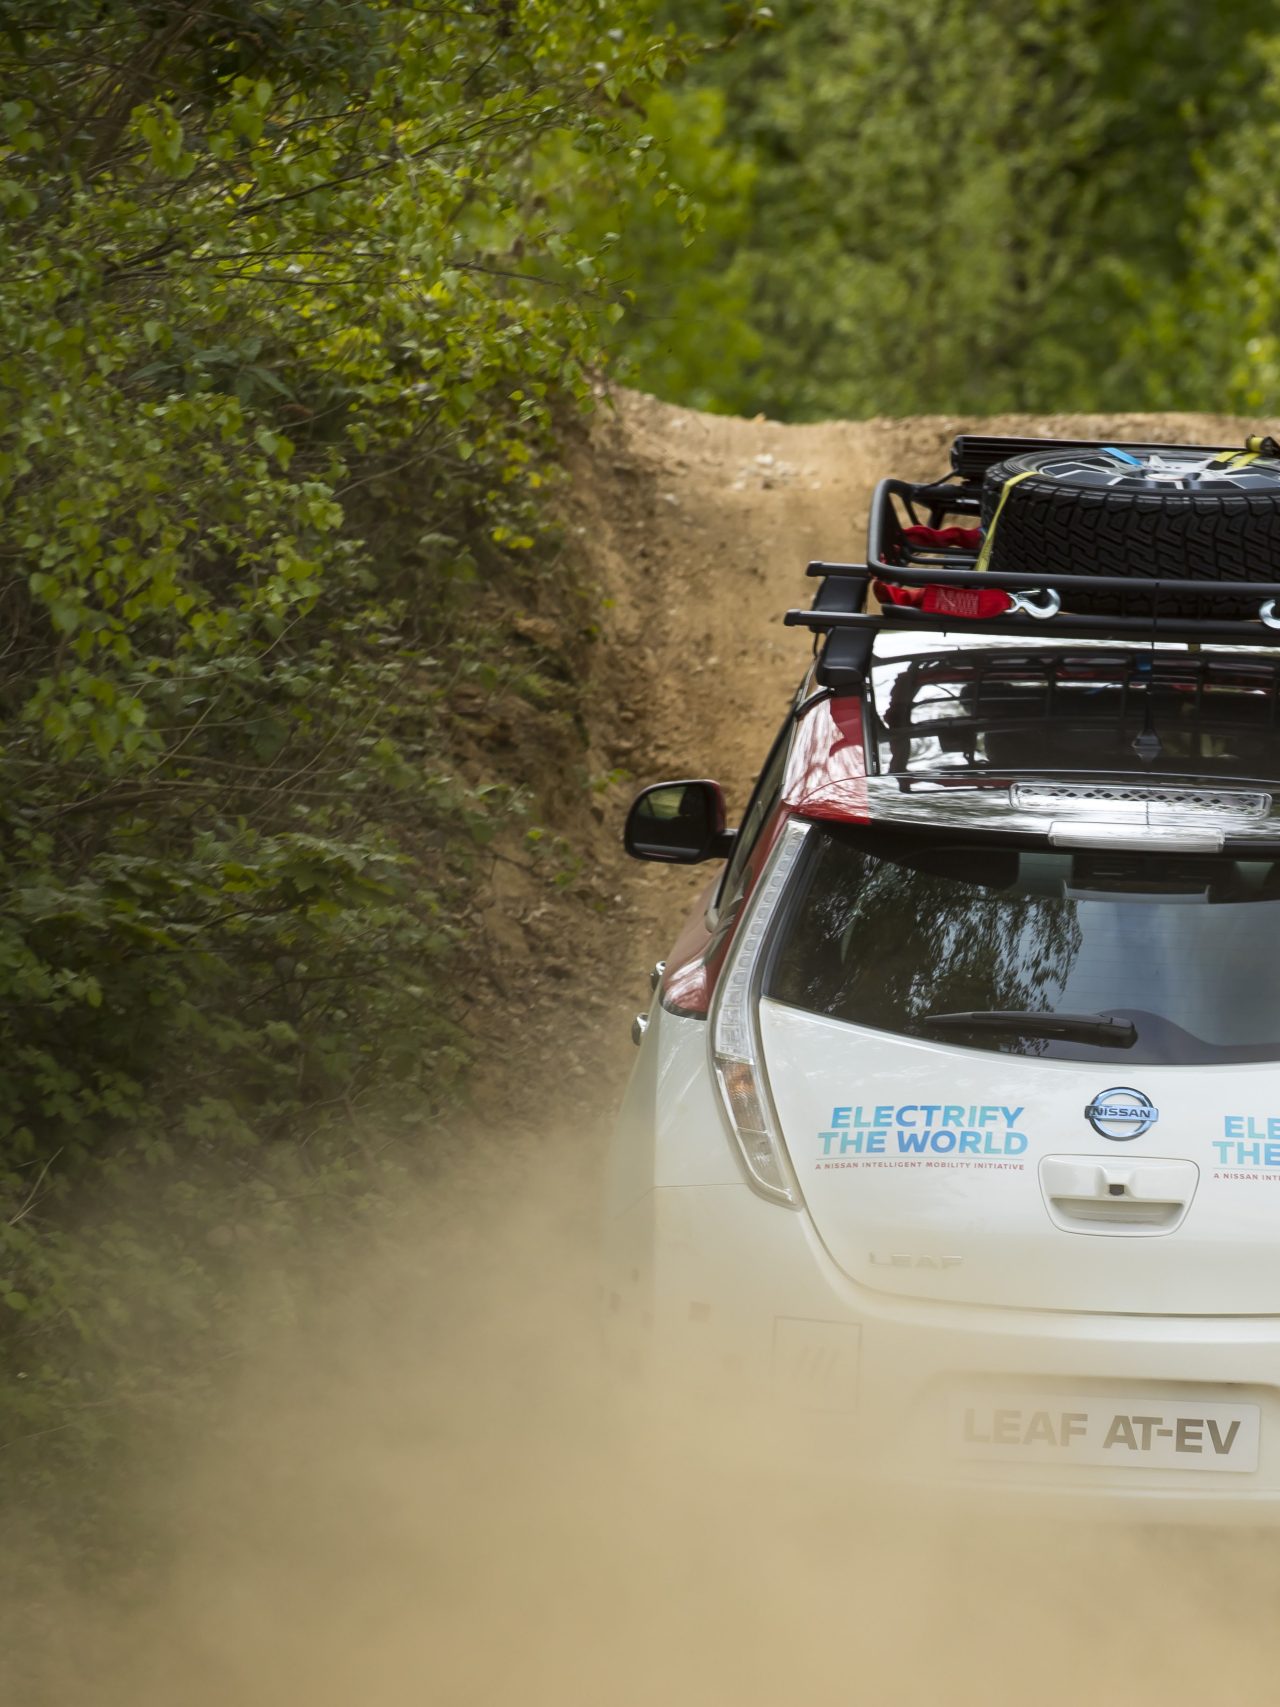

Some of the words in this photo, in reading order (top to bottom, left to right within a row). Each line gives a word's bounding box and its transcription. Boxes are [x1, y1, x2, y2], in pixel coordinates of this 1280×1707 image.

[831, 1105, 1025, 1129] ELECTRIFY
[1091, 1107, 1151, 1118] NISSAN
[817, 1130, 888, 1155] THE
[897, 1130, 1029, 1155] WORLD
[824, 1162, 859, 1170] NISSAN
[861, 1161, 923, 1169] INTELLIGENT
[925, 1161, 971, 1169] MOBILITY
[974, 1162, 1025, 1171] INITIATIVE
[963, 1407, 1089, 1448] LEAF
[1102, 1414, 1242, 1456] AT-EV
